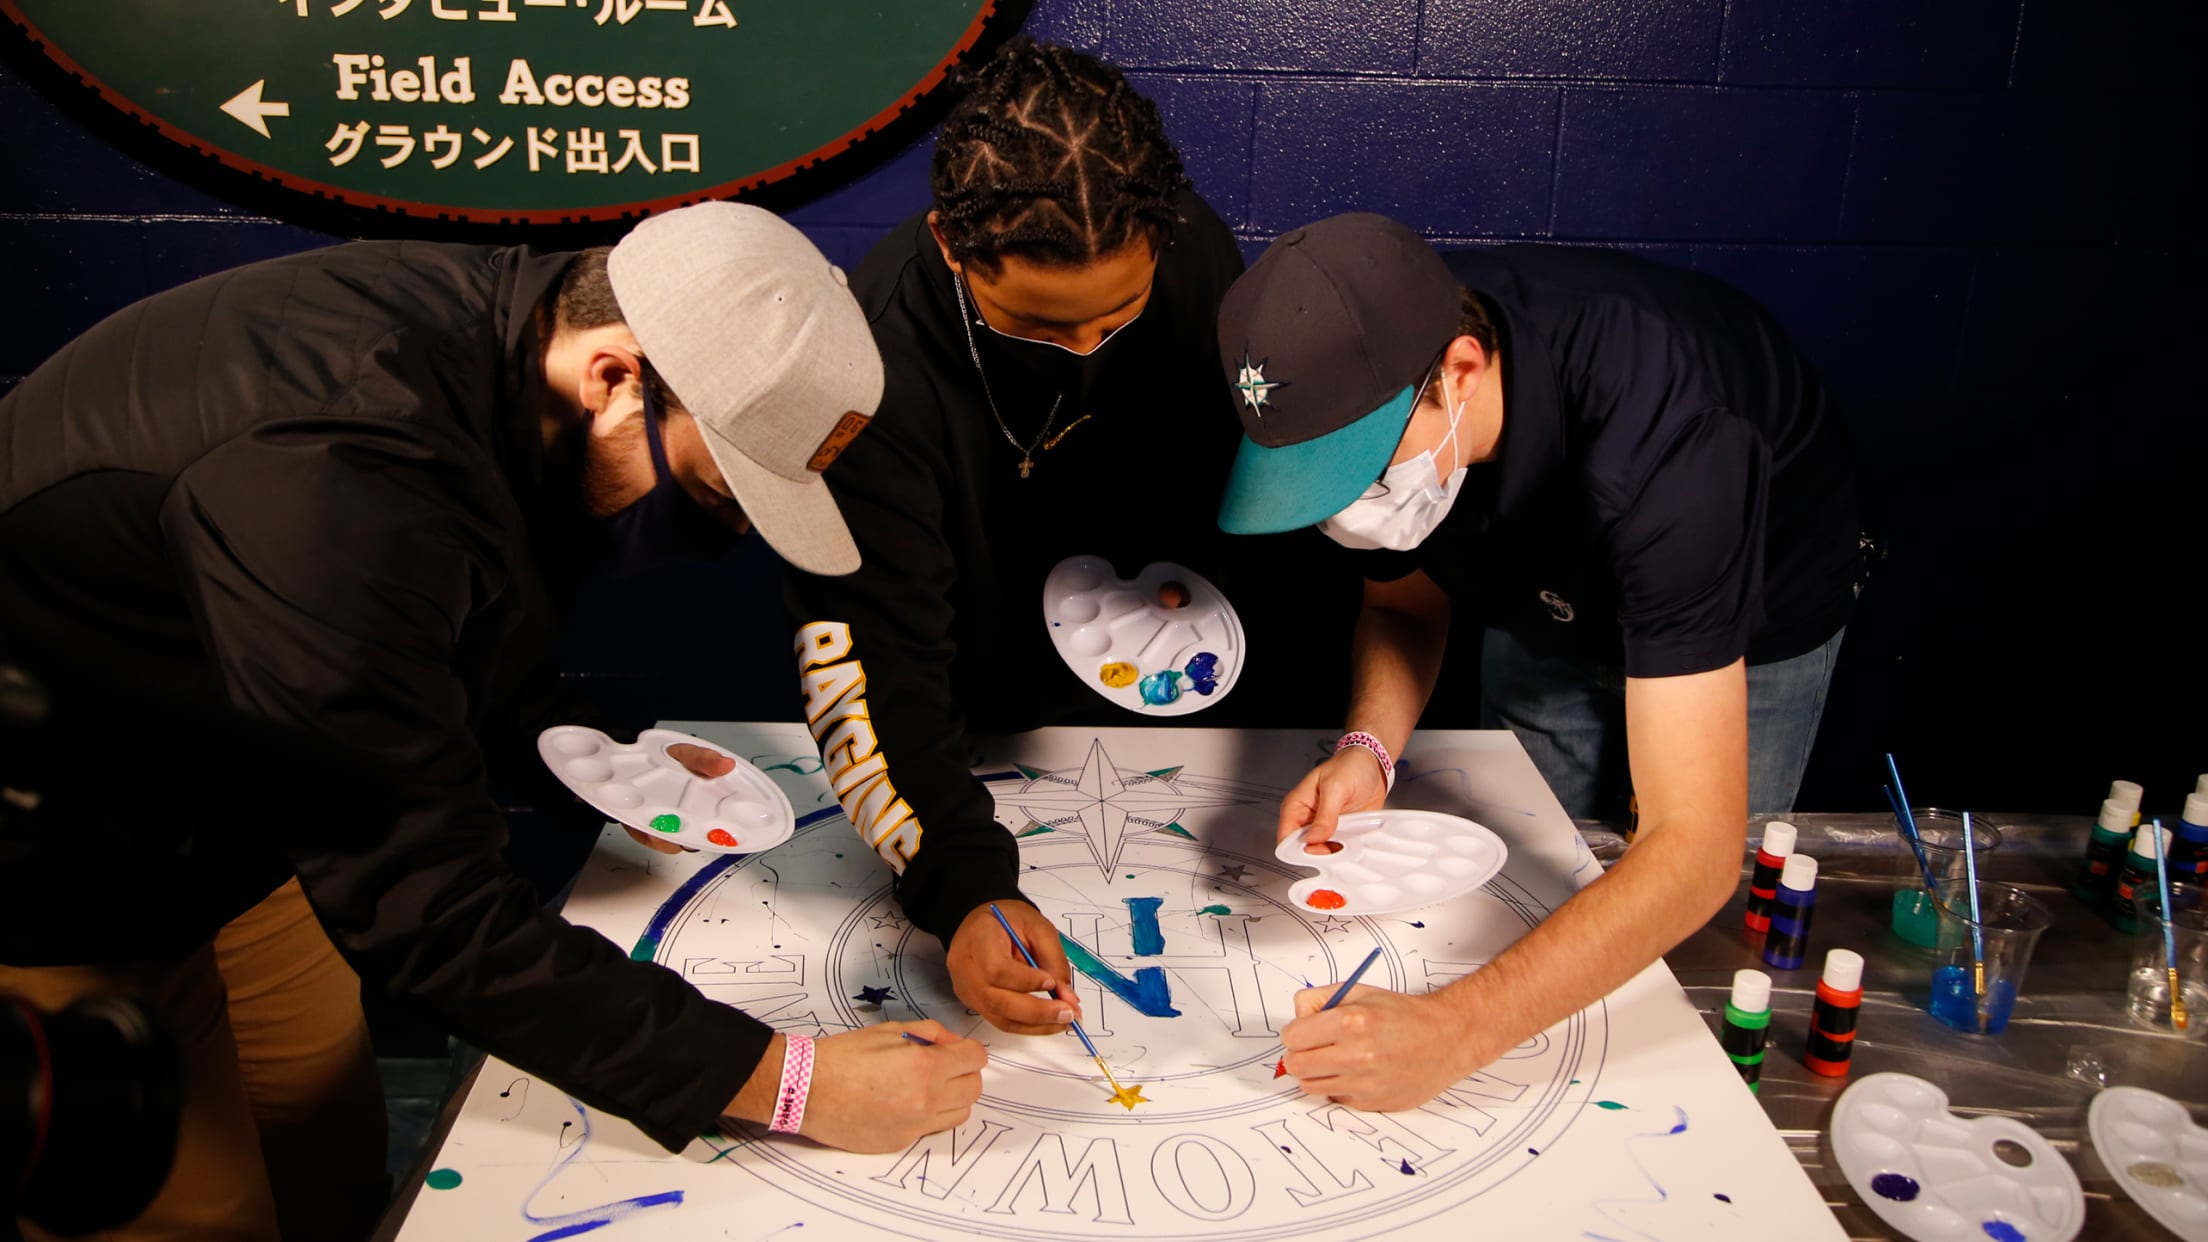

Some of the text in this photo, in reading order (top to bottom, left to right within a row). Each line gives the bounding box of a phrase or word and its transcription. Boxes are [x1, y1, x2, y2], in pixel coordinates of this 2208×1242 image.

[332, 53, 691, 109] Field Access
[325, 120, 701, 174] グラウンド出入口
[794, 620, 924, 877] RAYGING
[779, 1097, 794, 1125] GAME
